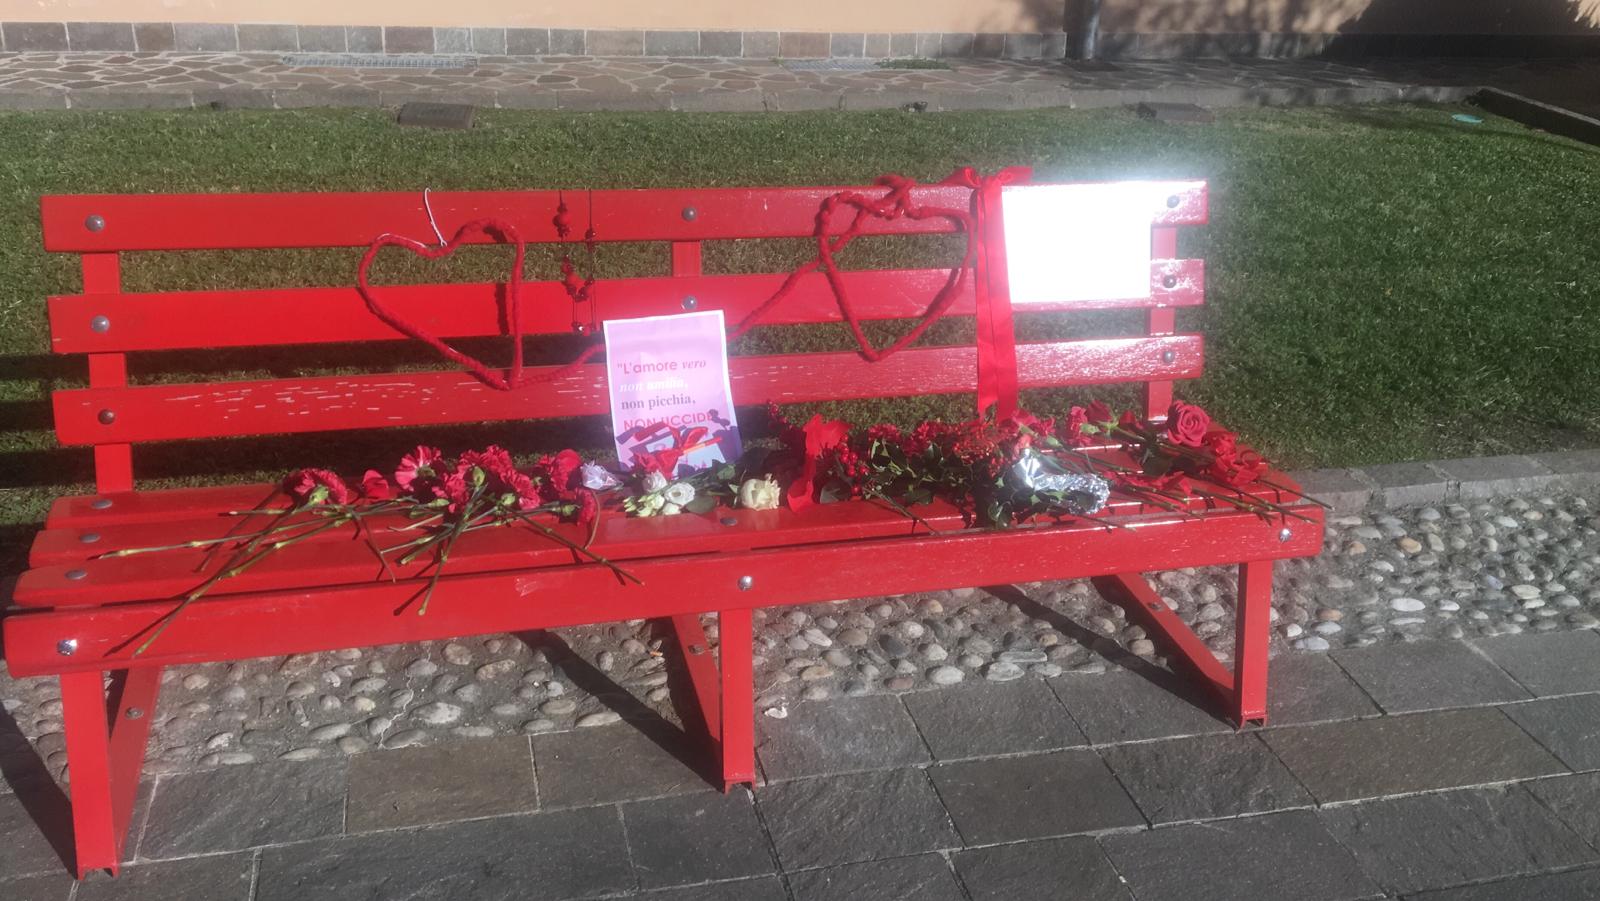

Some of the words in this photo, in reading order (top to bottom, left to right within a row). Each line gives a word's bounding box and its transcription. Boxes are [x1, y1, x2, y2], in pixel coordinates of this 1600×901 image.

[617, 361, 678, 375] "L'amore
[682, 360, 706, 369] vero
[619, 383, 643, 393] non
[621, 401, 645, 410] non
[648, 393, 696, 410] picchia,
[623, 417, 657, 431] NON
